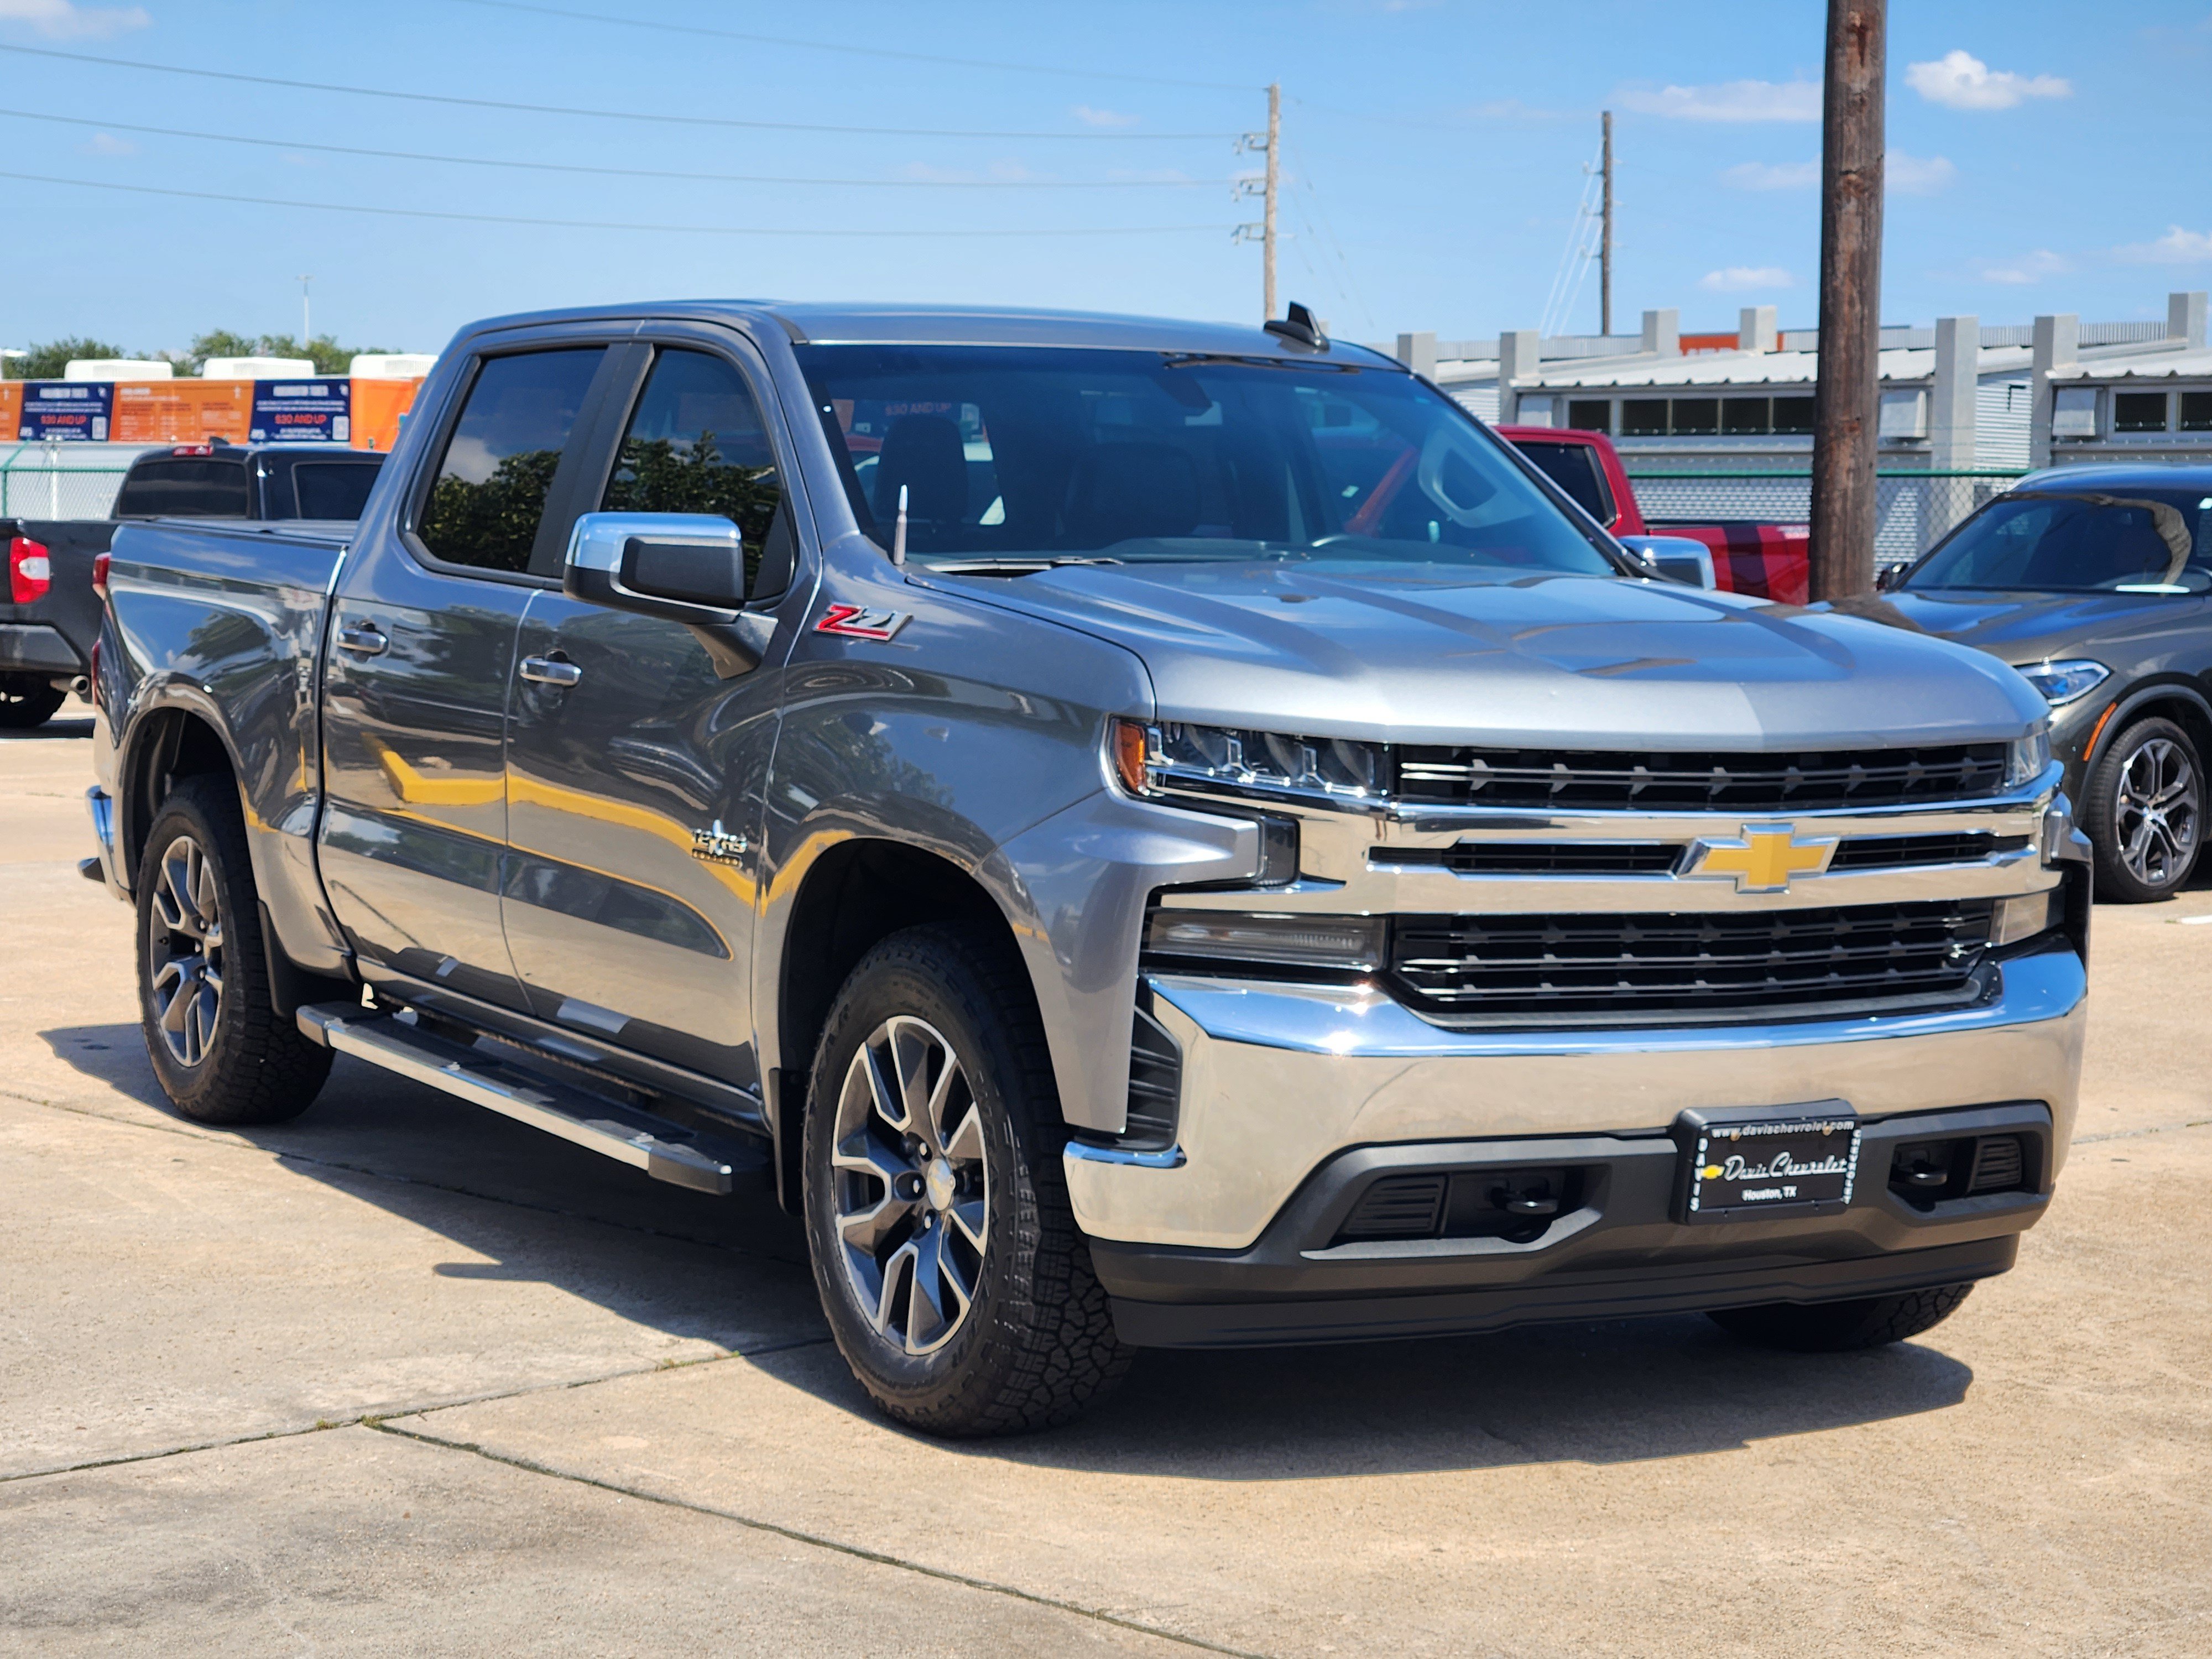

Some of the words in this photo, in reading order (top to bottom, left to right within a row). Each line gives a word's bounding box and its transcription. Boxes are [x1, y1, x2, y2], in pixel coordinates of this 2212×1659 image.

[294, 414, 314, 424] AND
[314, 414, 327, 424] UP
[814, 602, 914, 641] Z71
[691, 821, 747, 855] TEXAS
[1712, 1120, 1854, 1138] www.davischevroletcom
[1689, 1138, 1708, 1212] DAVIS
[1724, 1154, 1770, 1182] Davis
[1768, 1151, 1848, 1177] Chevrolet
[1841, 1129, 1861, 1204] CHEVROLET
[1742, 1188, 1782, 1201] Houston,
[1782, 1185, 1797, 1198] TX
